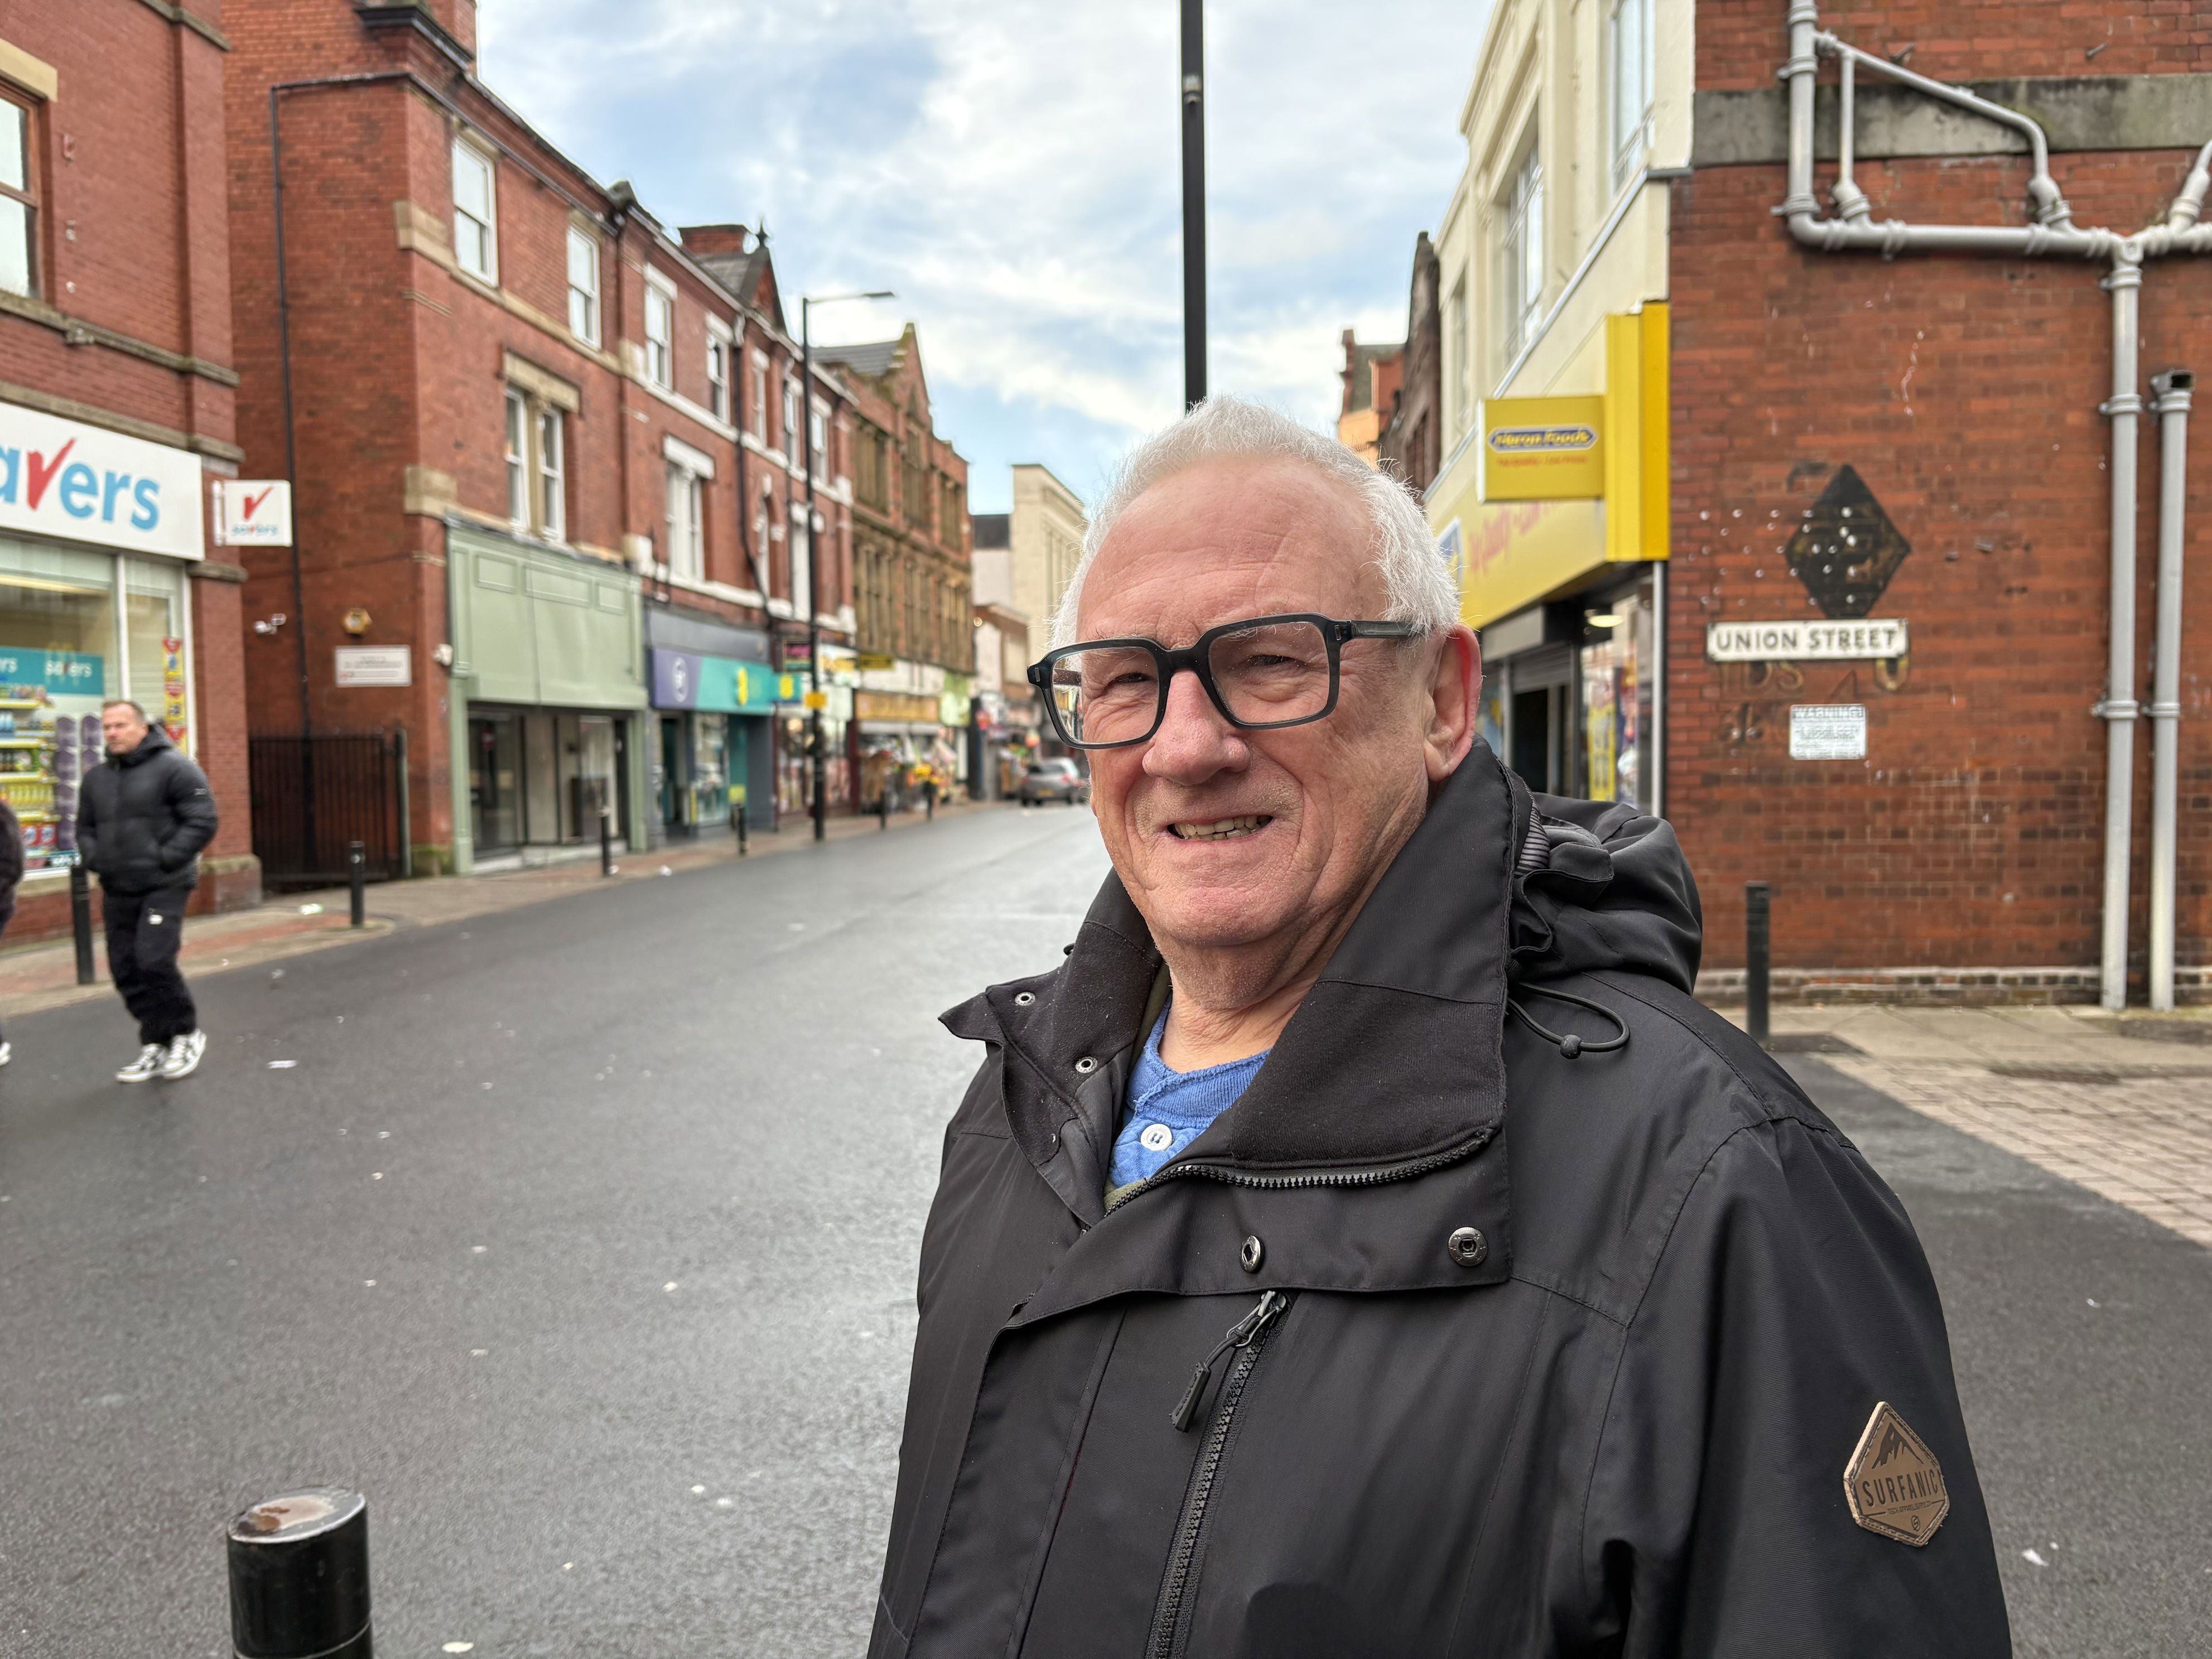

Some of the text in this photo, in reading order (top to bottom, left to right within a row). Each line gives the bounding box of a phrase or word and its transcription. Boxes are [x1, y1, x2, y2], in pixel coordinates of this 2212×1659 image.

[1544, 430, 1591, 445] Foods
[1717, 627, 1897, 652] UNION STREET
[1862, 1469, 1938, 1507] SURFANIC
